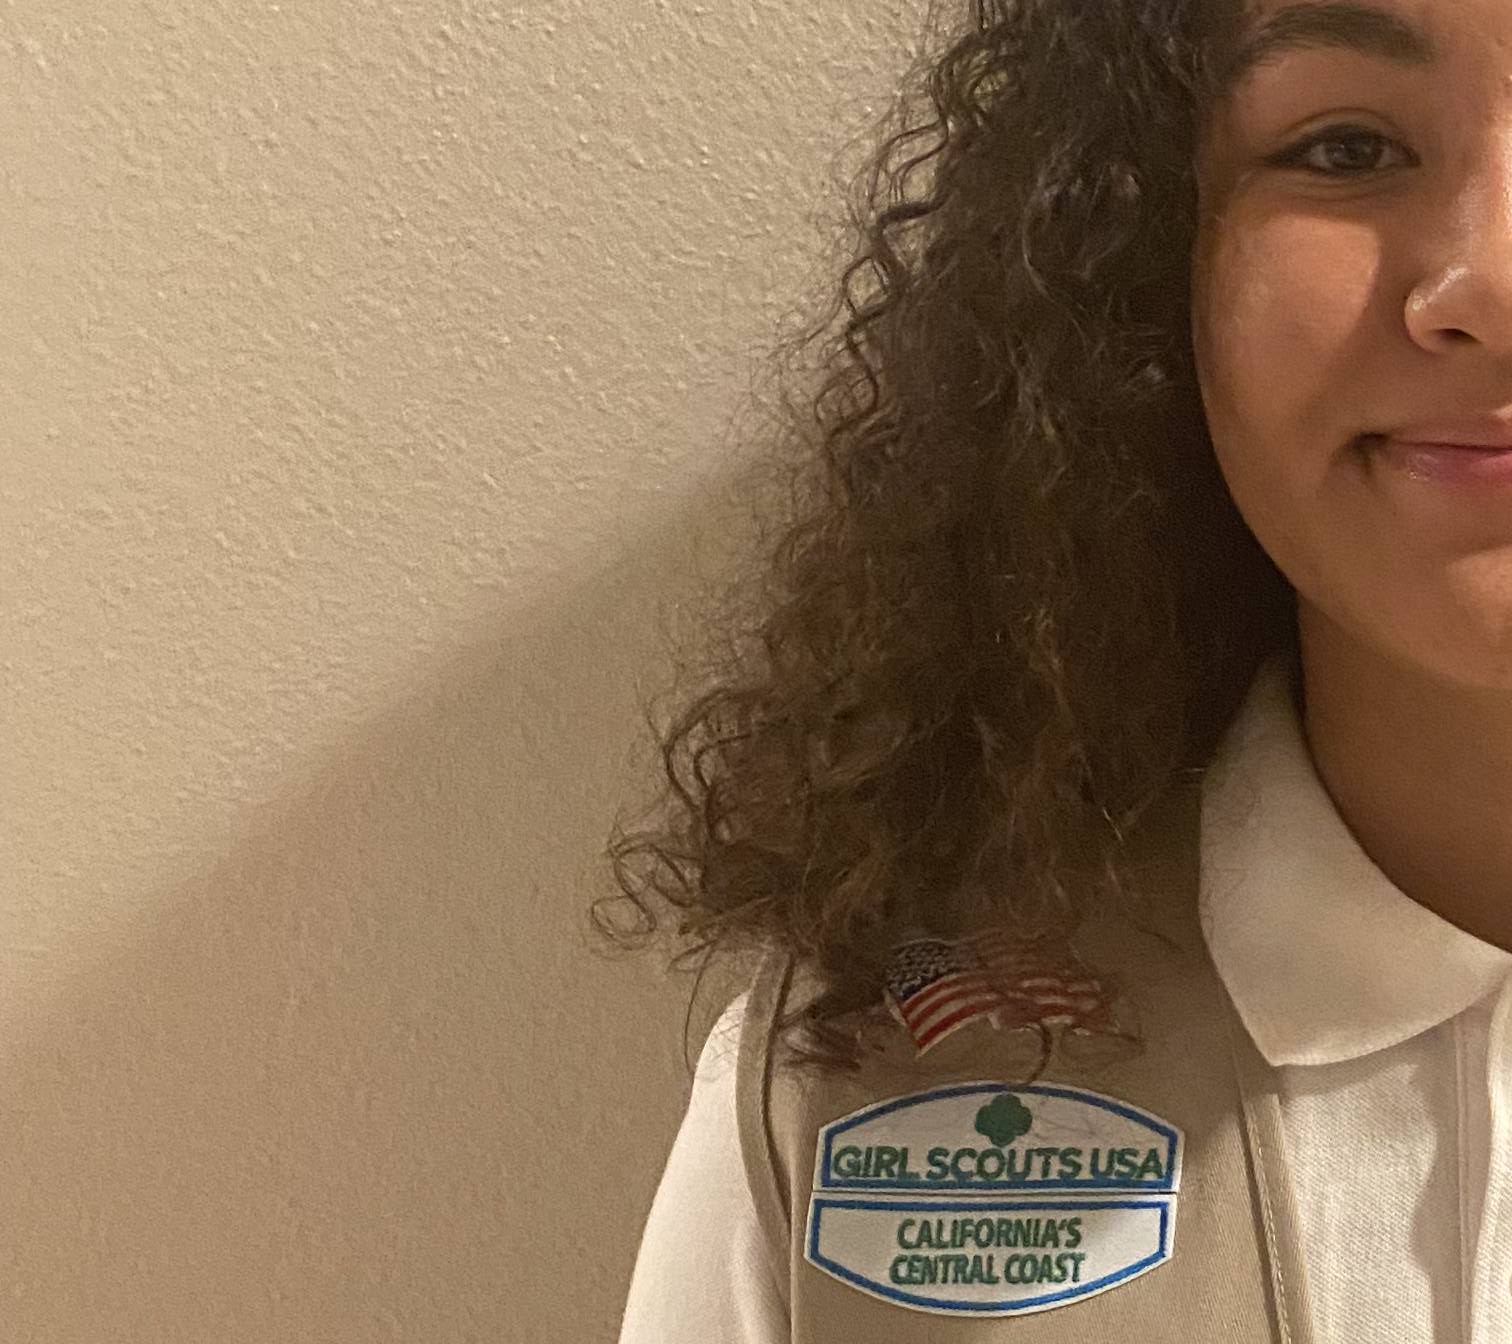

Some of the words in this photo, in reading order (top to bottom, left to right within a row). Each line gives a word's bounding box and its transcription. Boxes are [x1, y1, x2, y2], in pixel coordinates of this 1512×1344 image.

[833, 1145, 919, 1179] GIRL
[926, 1145, 1083, 1181] SCOUTS
[1089, 1146, 1164, 1180] USA
[897, 1217, 1083, 1249] CALIFORNIA'S
[889, 1254, 999, 1285] CENTRAL
[1003, 1252, 1086, 1285] COAST
